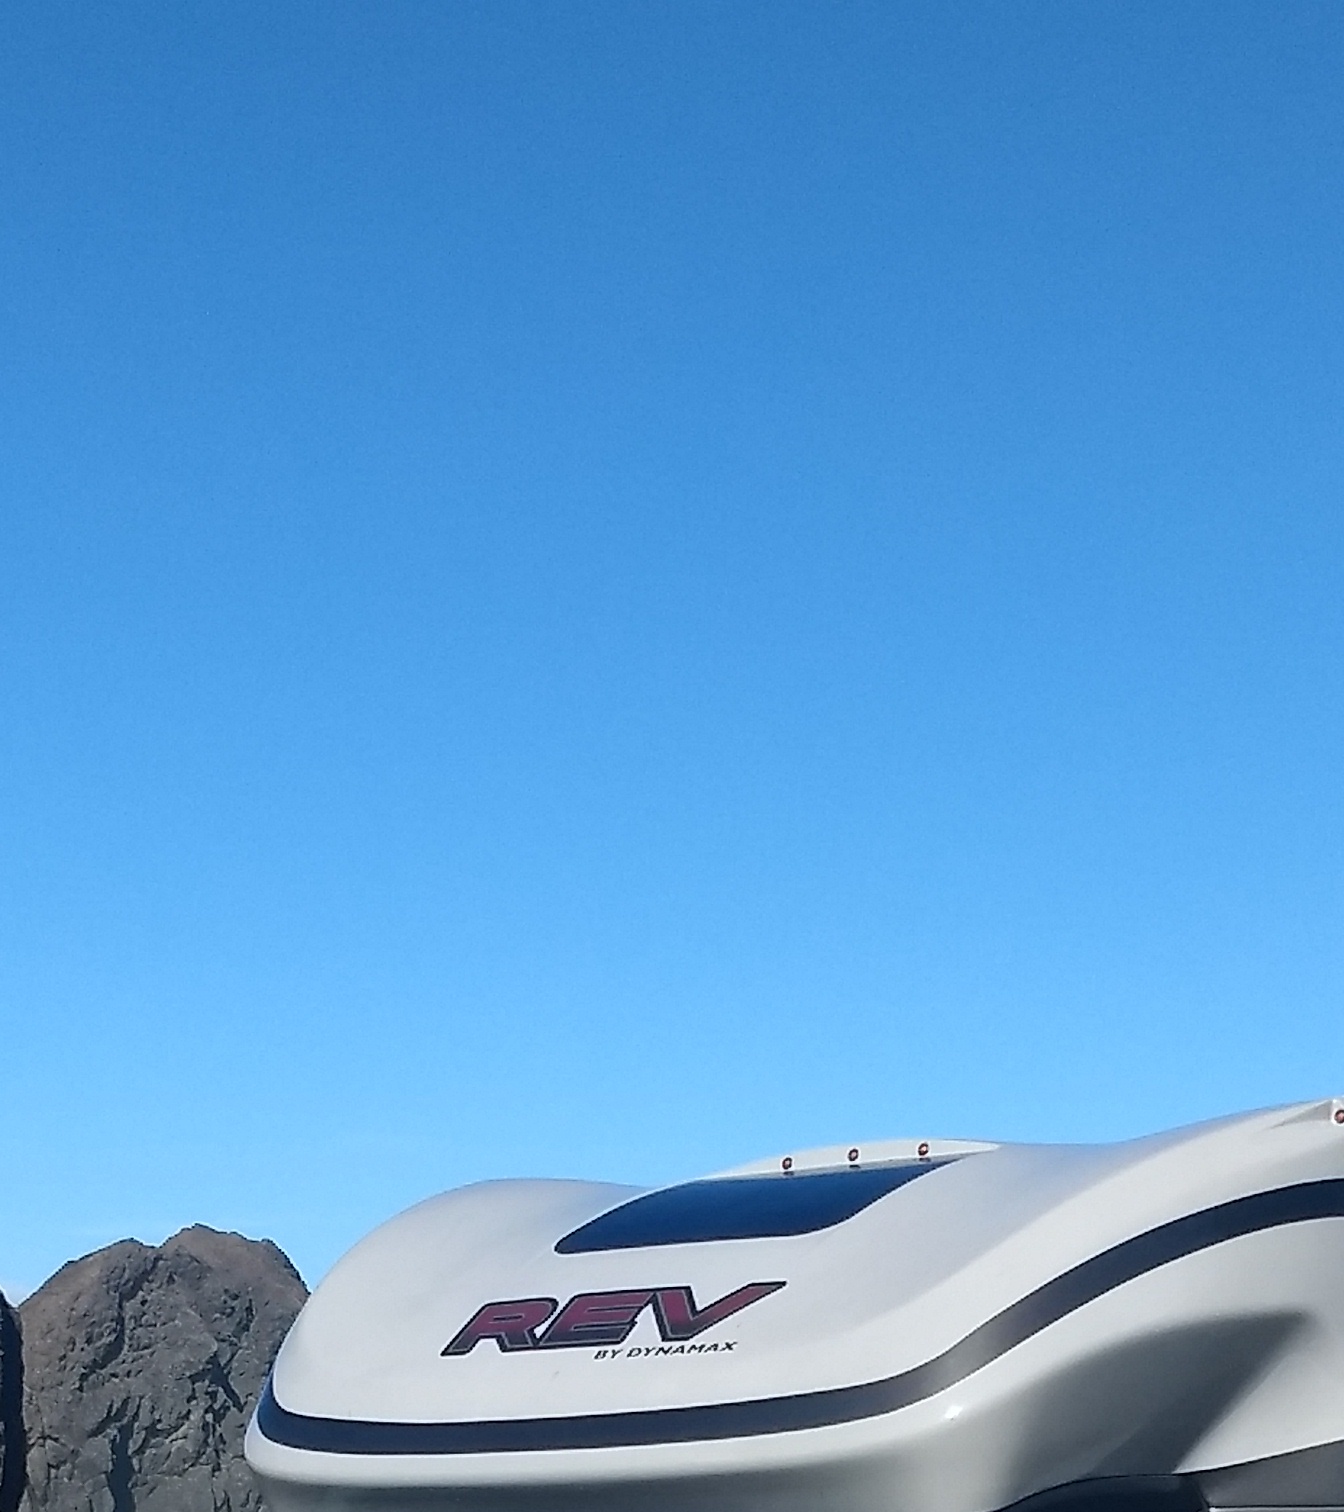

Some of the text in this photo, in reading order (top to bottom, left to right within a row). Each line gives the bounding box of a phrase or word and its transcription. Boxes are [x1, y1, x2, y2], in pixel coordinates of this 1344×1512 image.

[440, 1281, 787, 1357] REV
[594, 1341, 738, 1360] BY DYNAMAX
